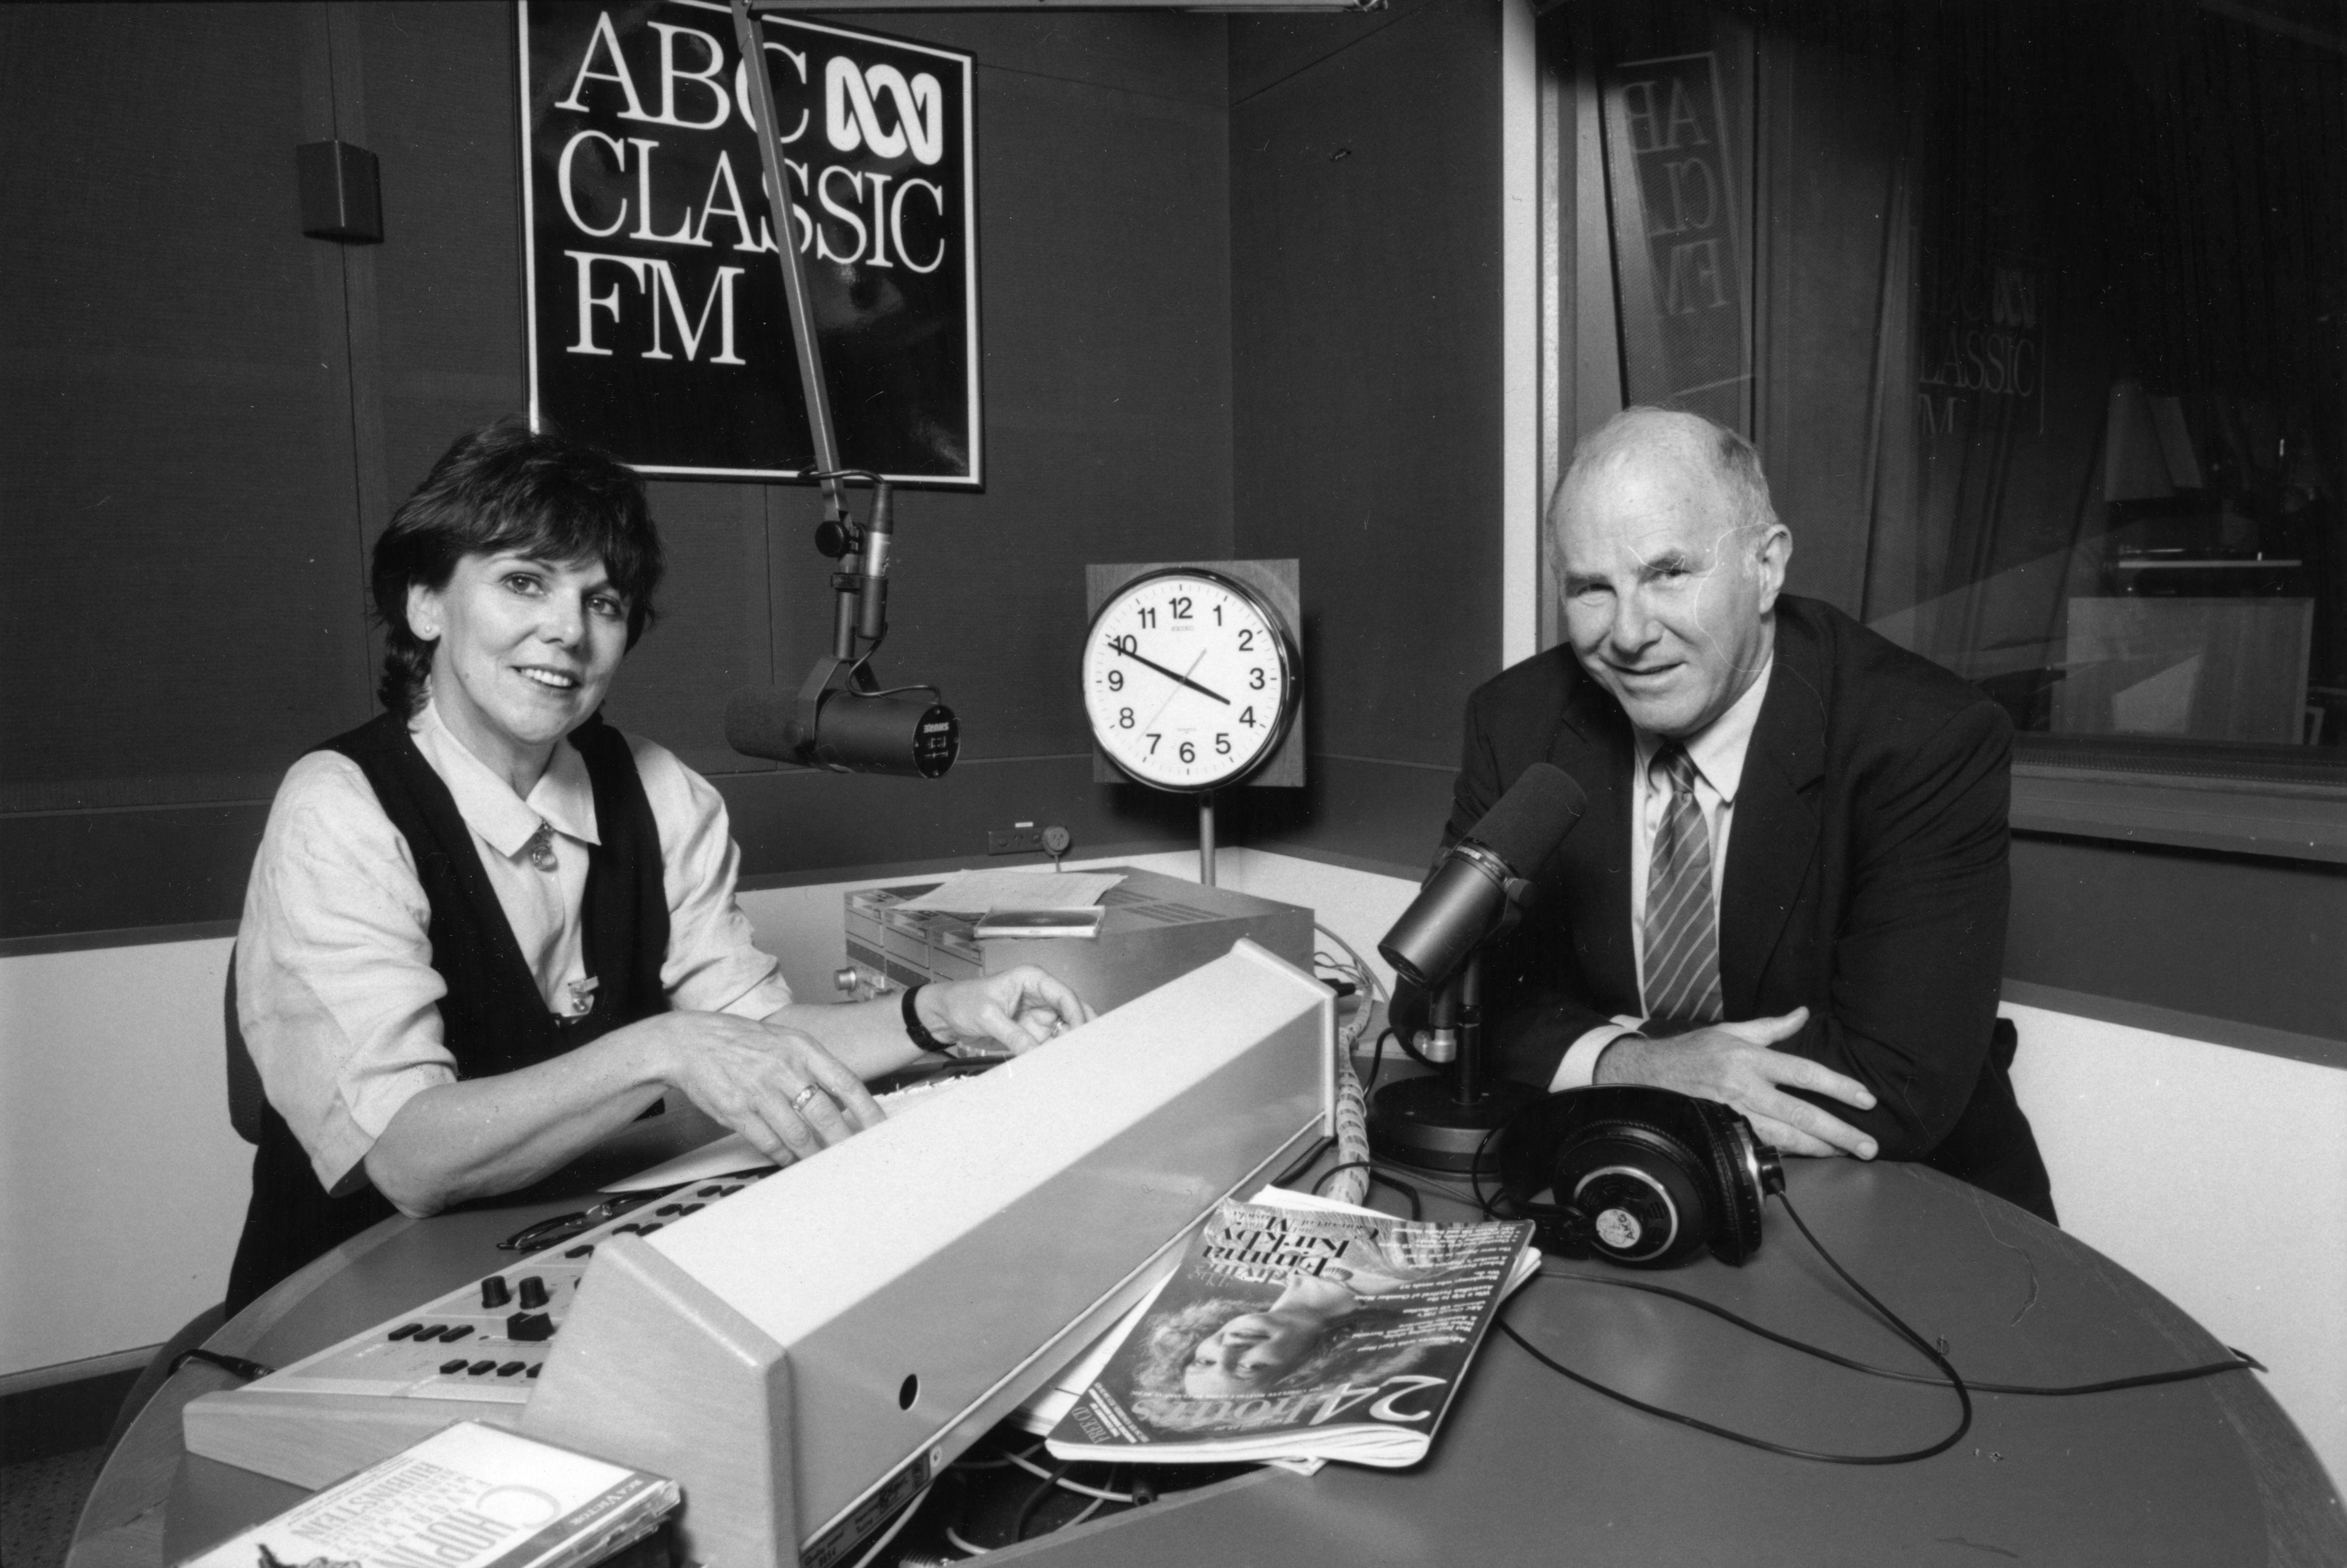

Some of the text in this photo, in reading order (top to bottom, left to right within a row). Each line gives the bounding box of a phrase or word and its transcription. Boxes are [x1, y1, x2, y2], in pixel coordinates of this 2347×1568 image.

[554, 10, 809, 144] ABC
[558, 129, 945, 274] CLASSIC
[564, 250, 746, 365] FM
[1137, 607, 1157, 629] 11
[1169, 597, 1193, 619] 12
[1213, 604, 1222, 627] 1
[1113, 634, 1138, 656] 10
[1238, 629, 1254, 652] 2
[1108, 670, 1124, 692] 9
[1249, 667, 1266, 690] 3
[923, 722, 950, 733] SHURE
[1119, 707, 1135, 729] 8
[1239, 706, 1257, 728] 4
[1146, 733, 1162, 755] 7
[1179, 741, 1195, 764] 6
[1215, 733, 1231, 755] 5
[1456, 845, 1482, 860] SHURE
[1618, 1213, 1635, 1241] AKG
[1214, 1221, 1351, 1258] Kirkby
[1202, 1245, 1329, 1277] Emma
[1421, 1289, 1452, 1298] Festival
[1453, 1284, 1494, 1293] Australian
[1131, 1394, 1312, 1424] hours
[1308, 1375, 1447, 1426] 24
[1071, 1407, 1110, 1444] FREE CD
[290, 1461, 444, 1542] RUBINSTEIN
[569, 1495, 624, 1526] VICTOR
